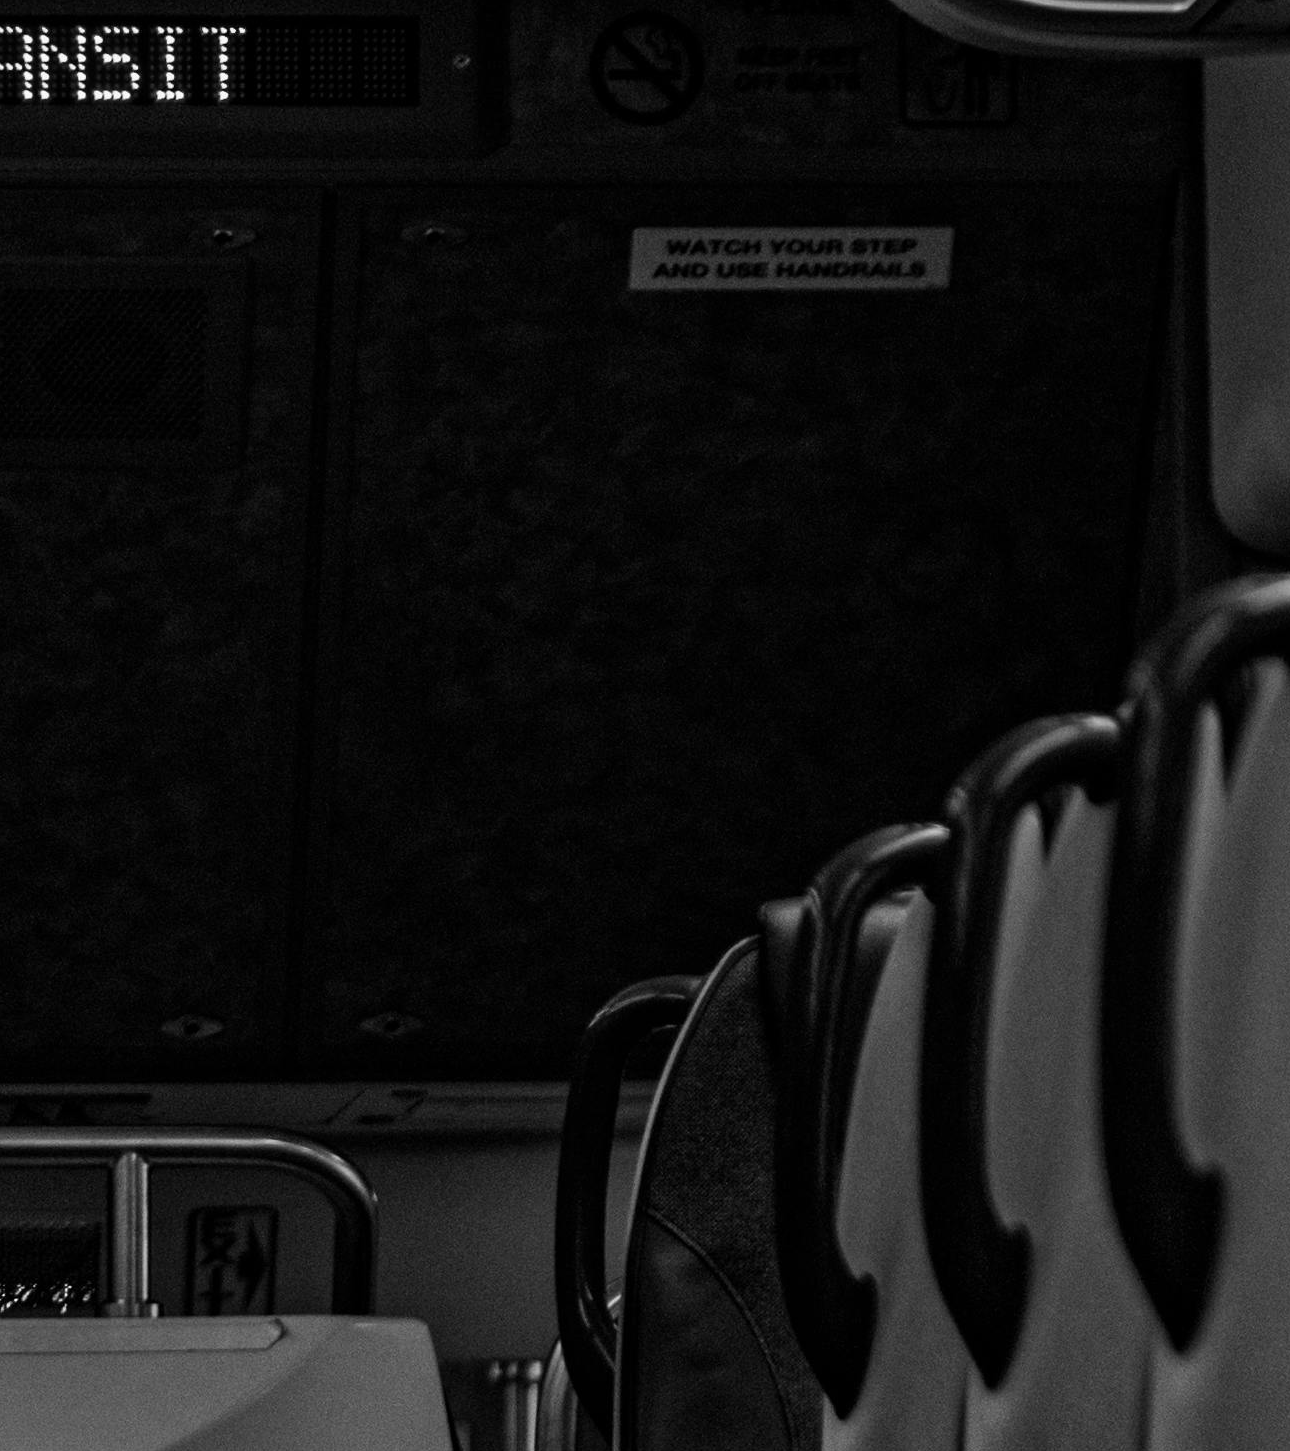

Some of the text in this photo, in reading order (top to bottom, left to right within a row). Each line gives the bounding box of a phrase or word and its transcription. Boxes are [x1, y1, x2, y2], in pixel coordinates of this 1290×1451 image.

[665, 239, 918, 255] WATCH YOUR STEP
[652, 262, 926, 279] AND USE HANDRAILS
